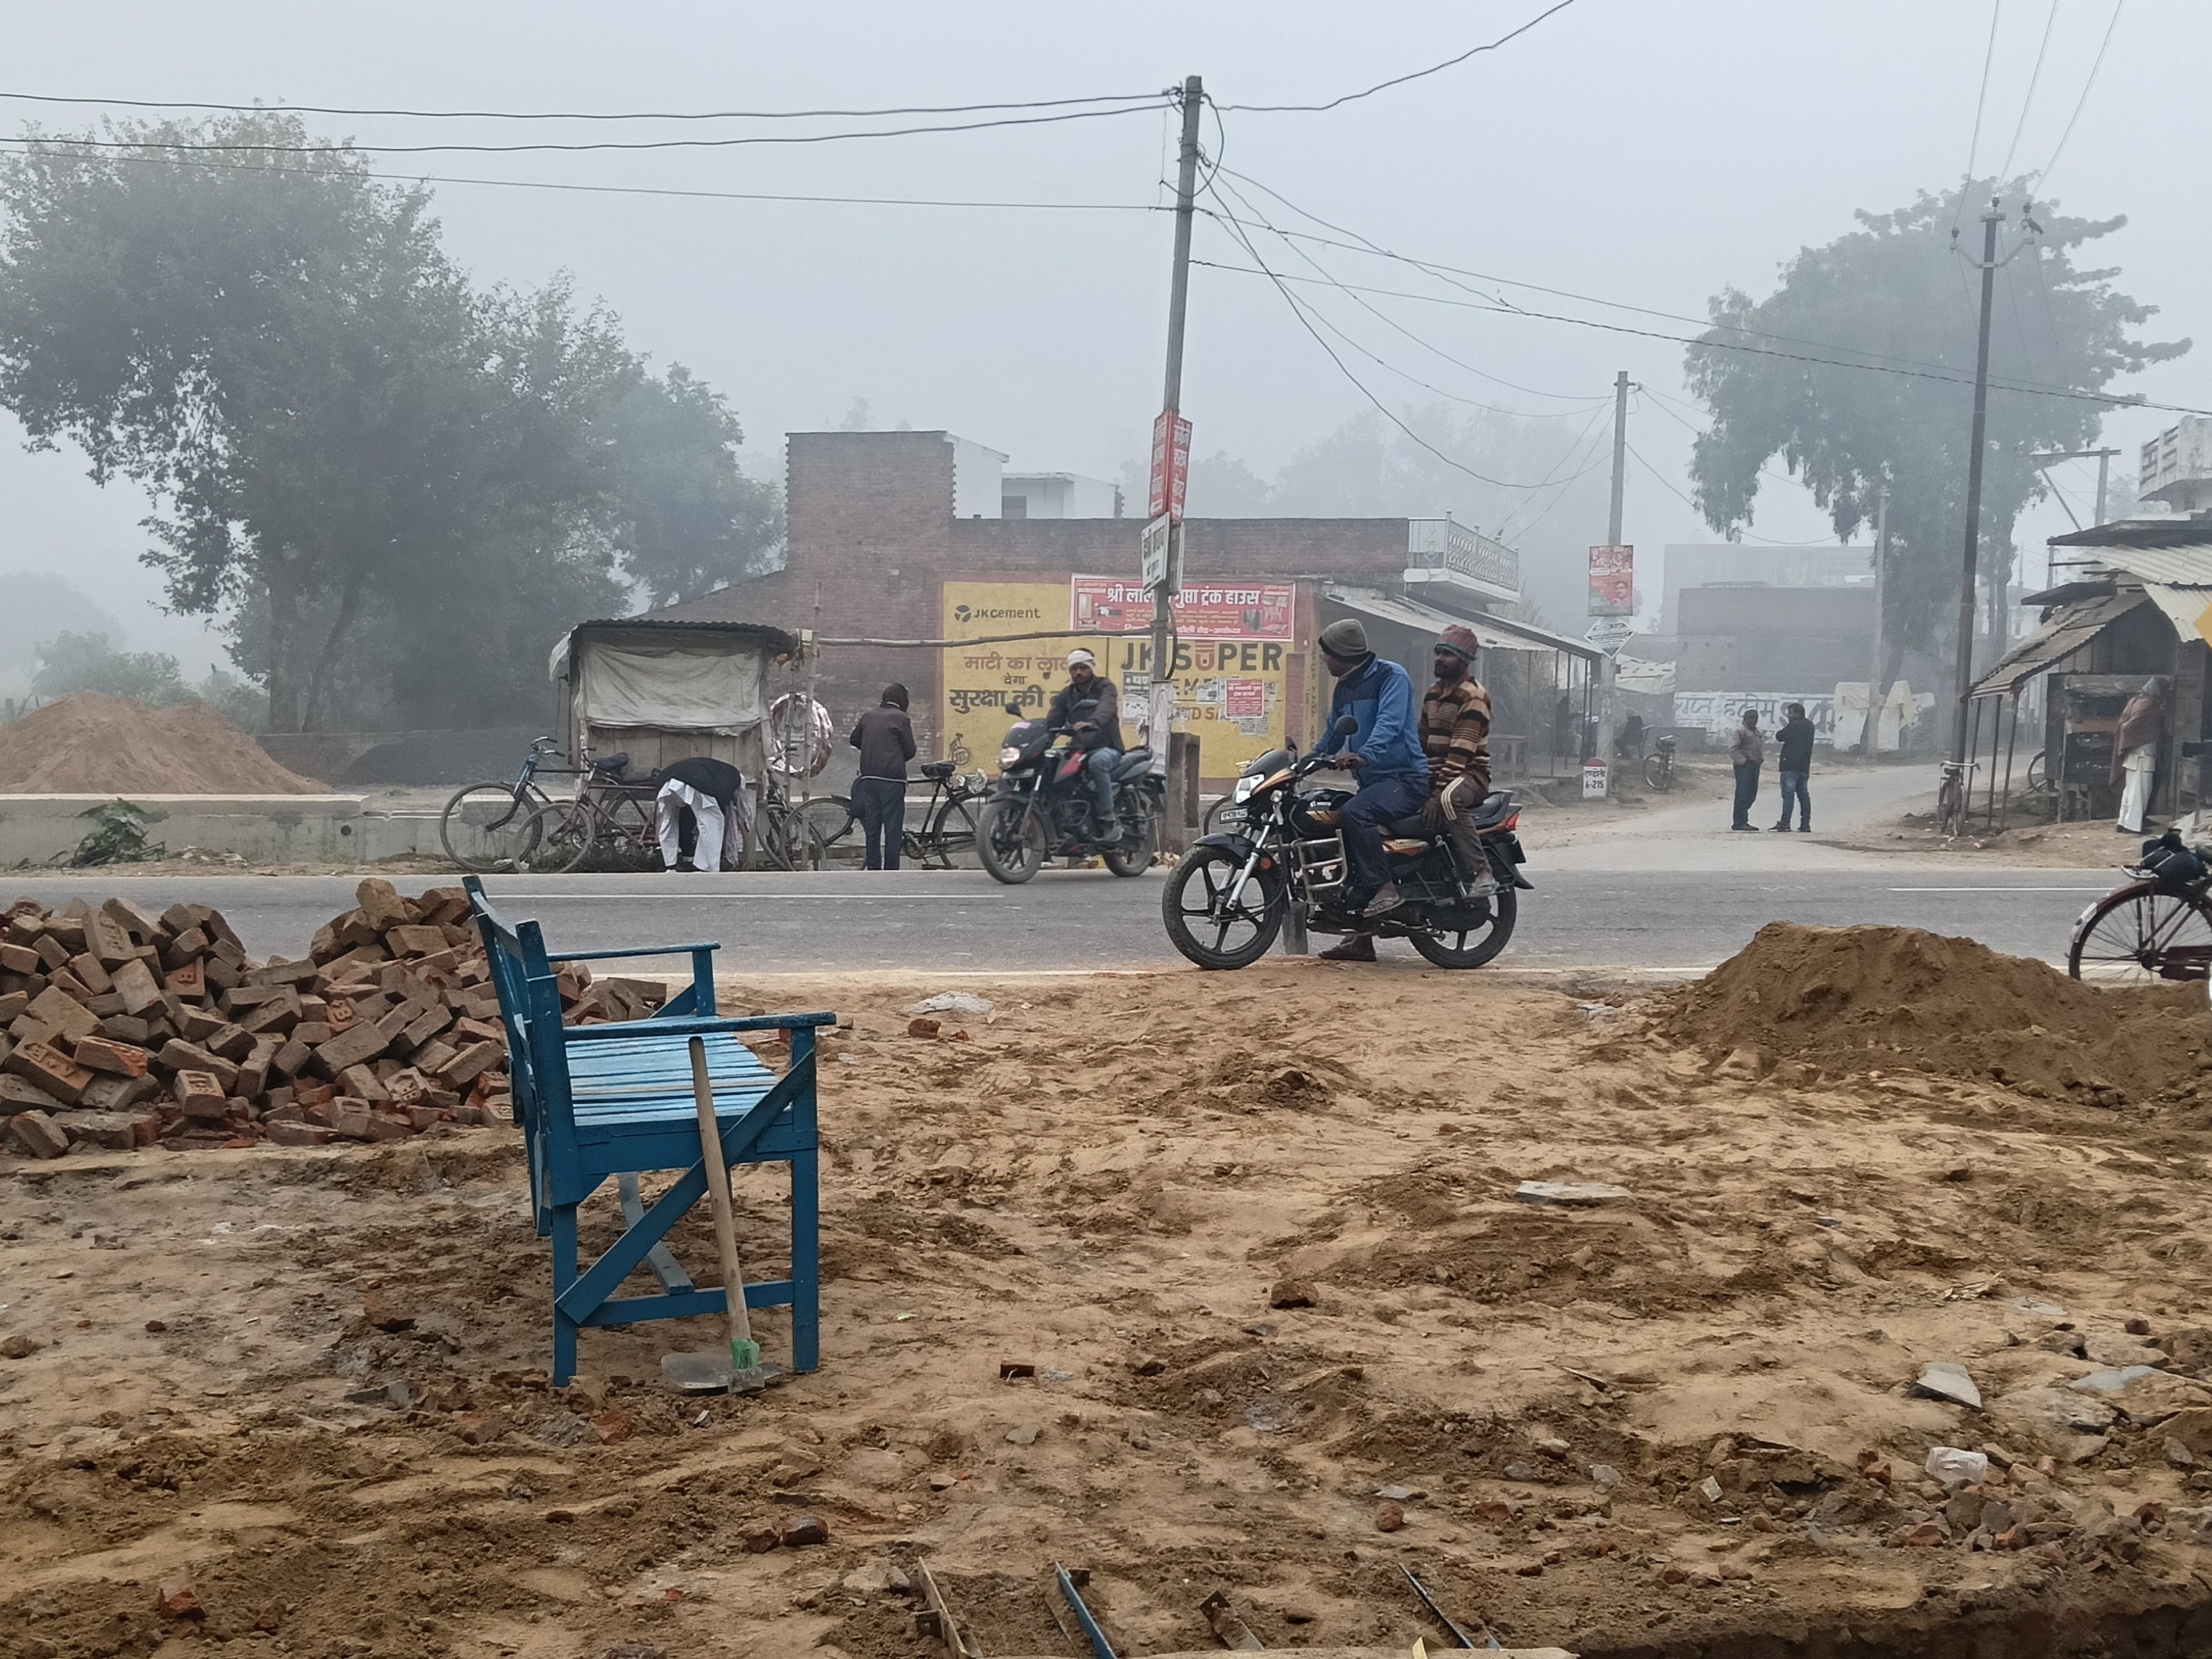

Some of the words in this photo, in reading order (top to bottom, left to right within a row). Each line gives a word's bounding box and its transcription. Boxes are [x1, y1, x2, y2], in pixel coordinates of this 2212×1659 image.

[1107, 584, 1125, 603] श्री
[1224, 590, 1261, 605] हाउस
[963, 651, 1003, 670] माटी
[1006, 657, 1032, 670] का
[1174, 639, 1282, 671] SUPER
[949, 689, 1008, 714] सुरक्षा
[1012, 684, 1046, 708] की
